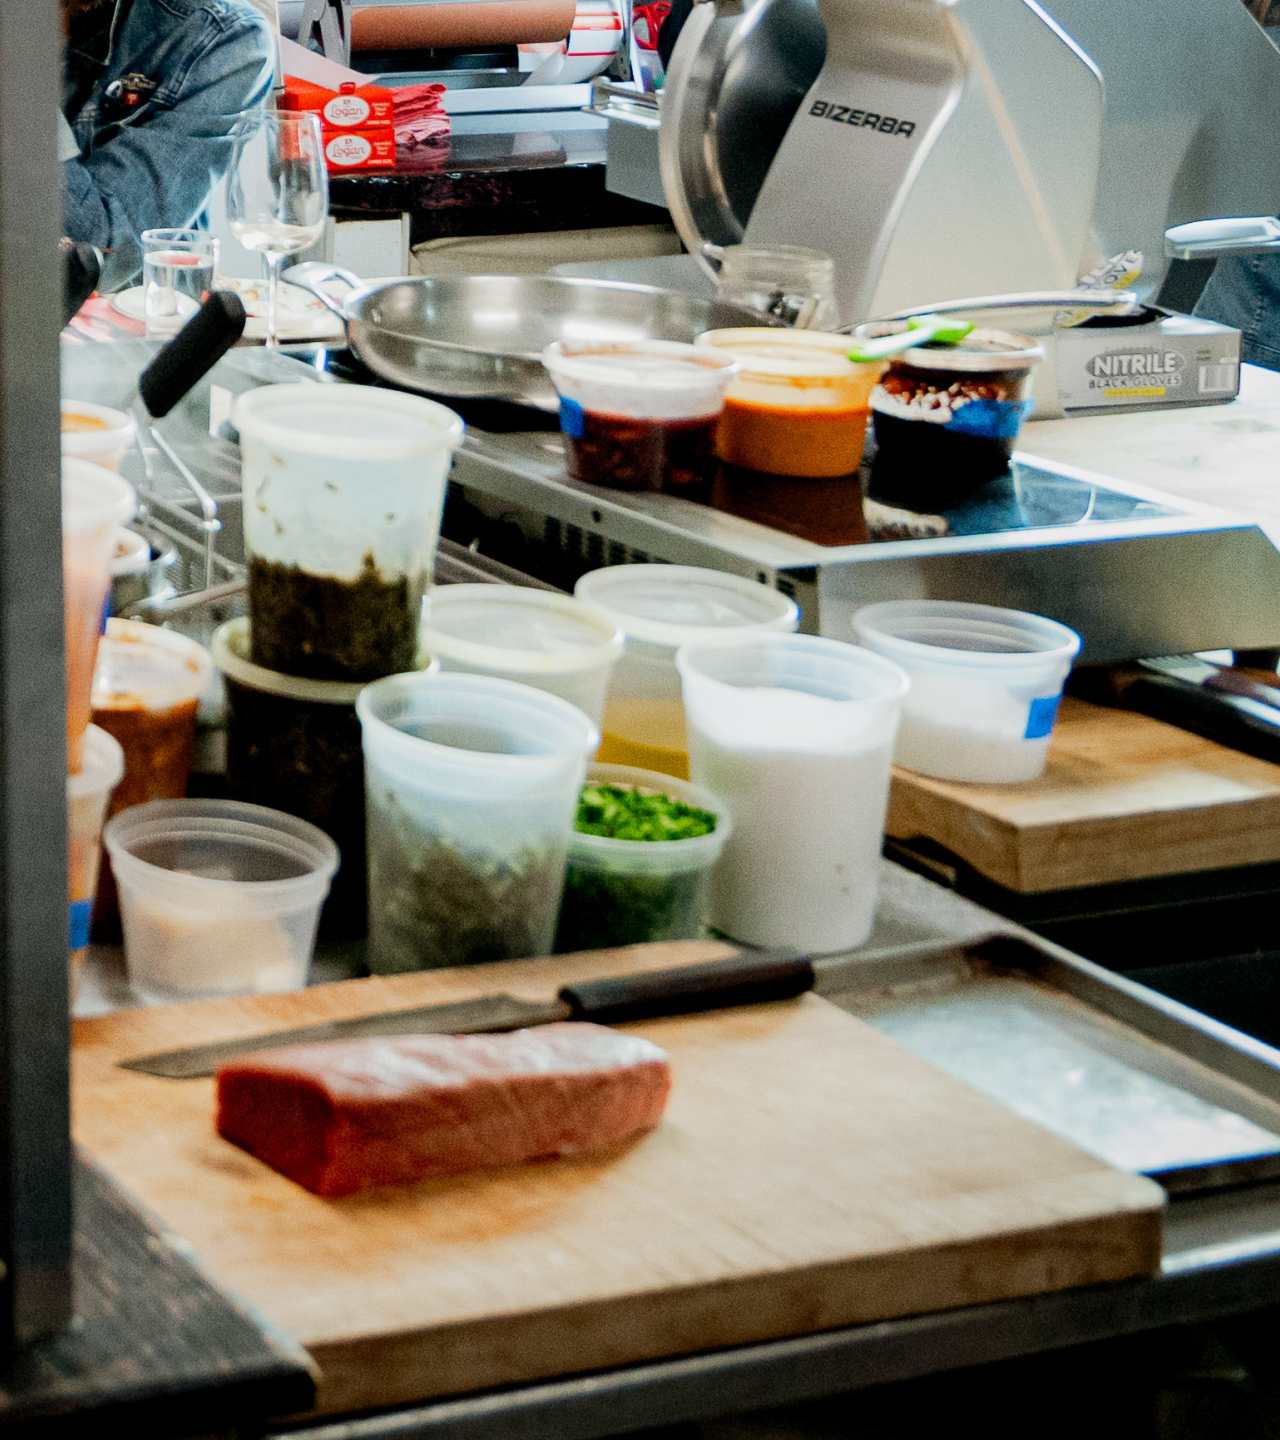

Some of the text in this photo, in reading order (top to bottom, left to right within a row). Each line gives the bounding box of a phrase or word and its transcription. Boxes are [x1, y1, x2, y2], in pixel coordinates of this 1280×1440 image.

[809, 100, 916, 139] BIZERBA
[1094, 351, 1178, 377] NITRILE
[1089, 374, 1183, 389] BLACK GLOVES
